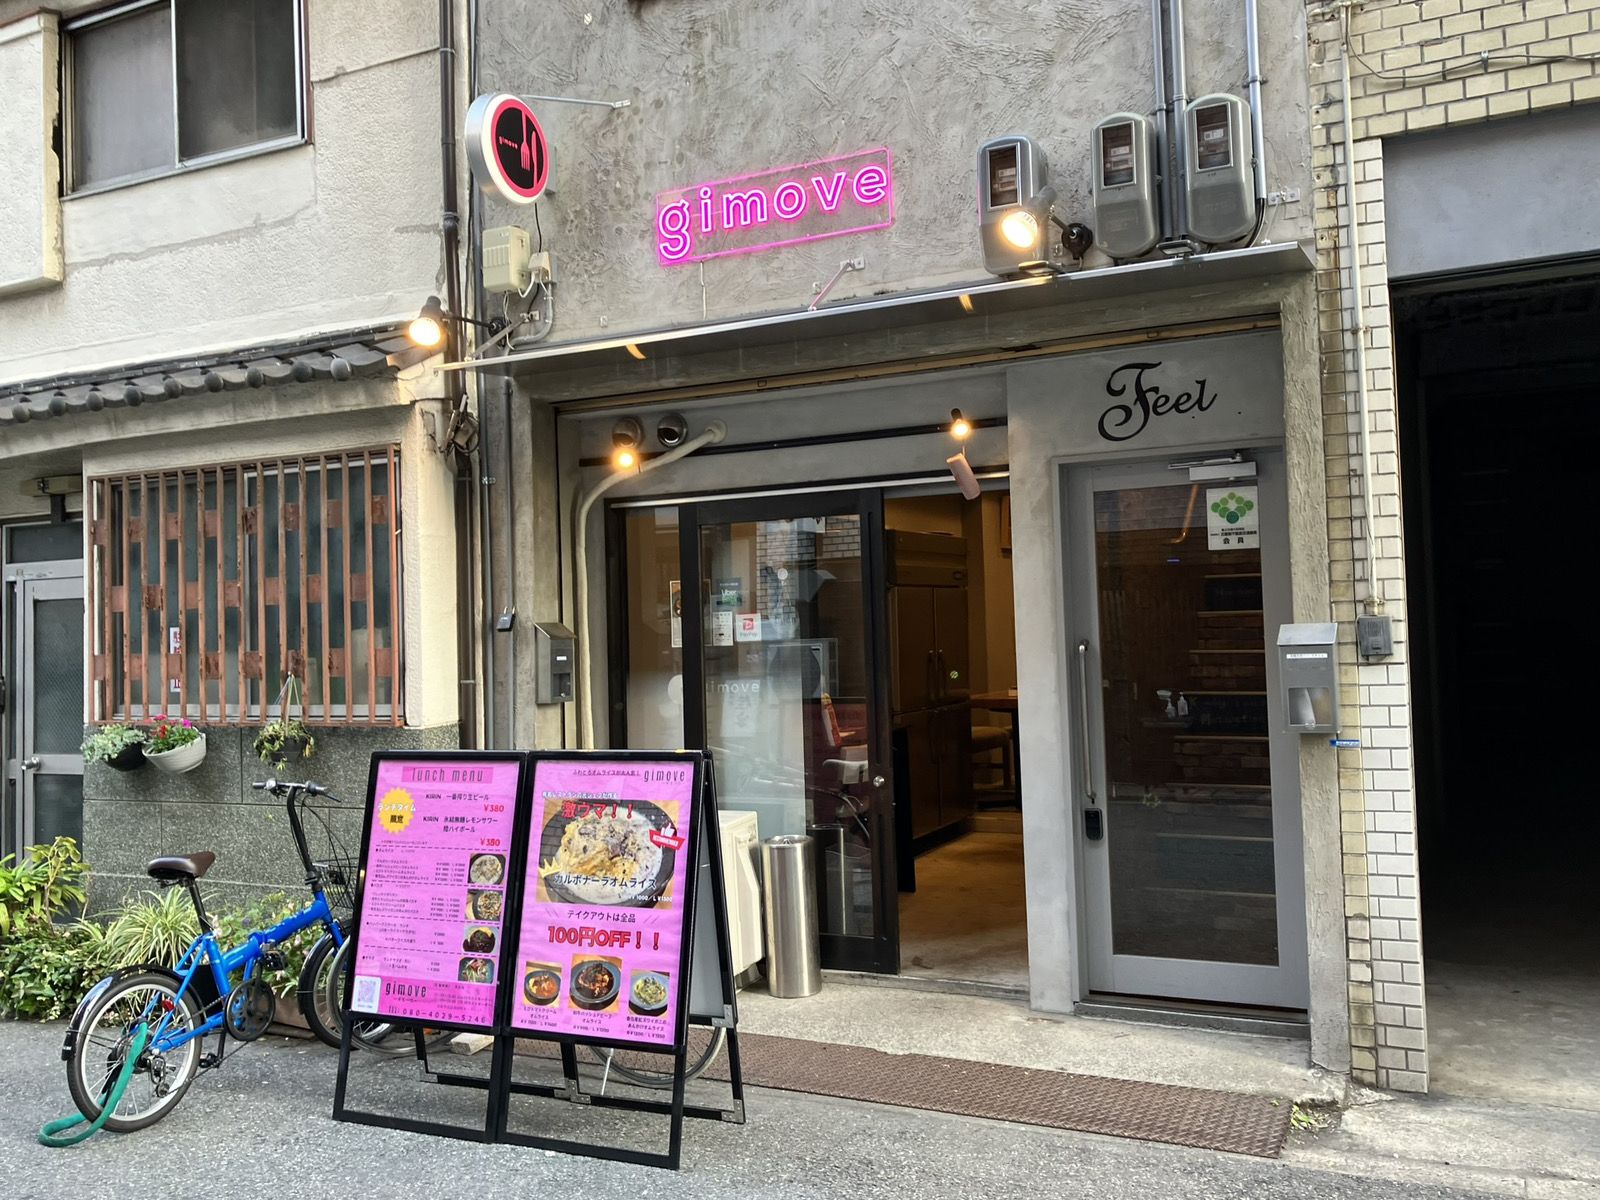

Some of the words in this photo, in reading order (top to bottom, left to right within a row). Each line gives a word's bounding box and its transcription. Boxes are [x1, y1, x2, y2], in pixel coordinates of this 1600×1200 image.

[499, 136, 518, 150] gimove
[658, 164, 888, 260] gimove
[1098, 361, 1218, 442] Feel
[706, 680, 760, 694] imove
[411, 767, 446, 782] lunch
[452, 769, 484, 782] menu
[644, 769, 686, 783] gimove
[483, 804, 505, 813] ¥380
[480, 838, 501, 847] ¥380
[554, 874, 657, 889] カルボナーラオムライス
[567, 909, 636, 923] テイクアウトは全品
[385, 981, 427, 998] gimove
